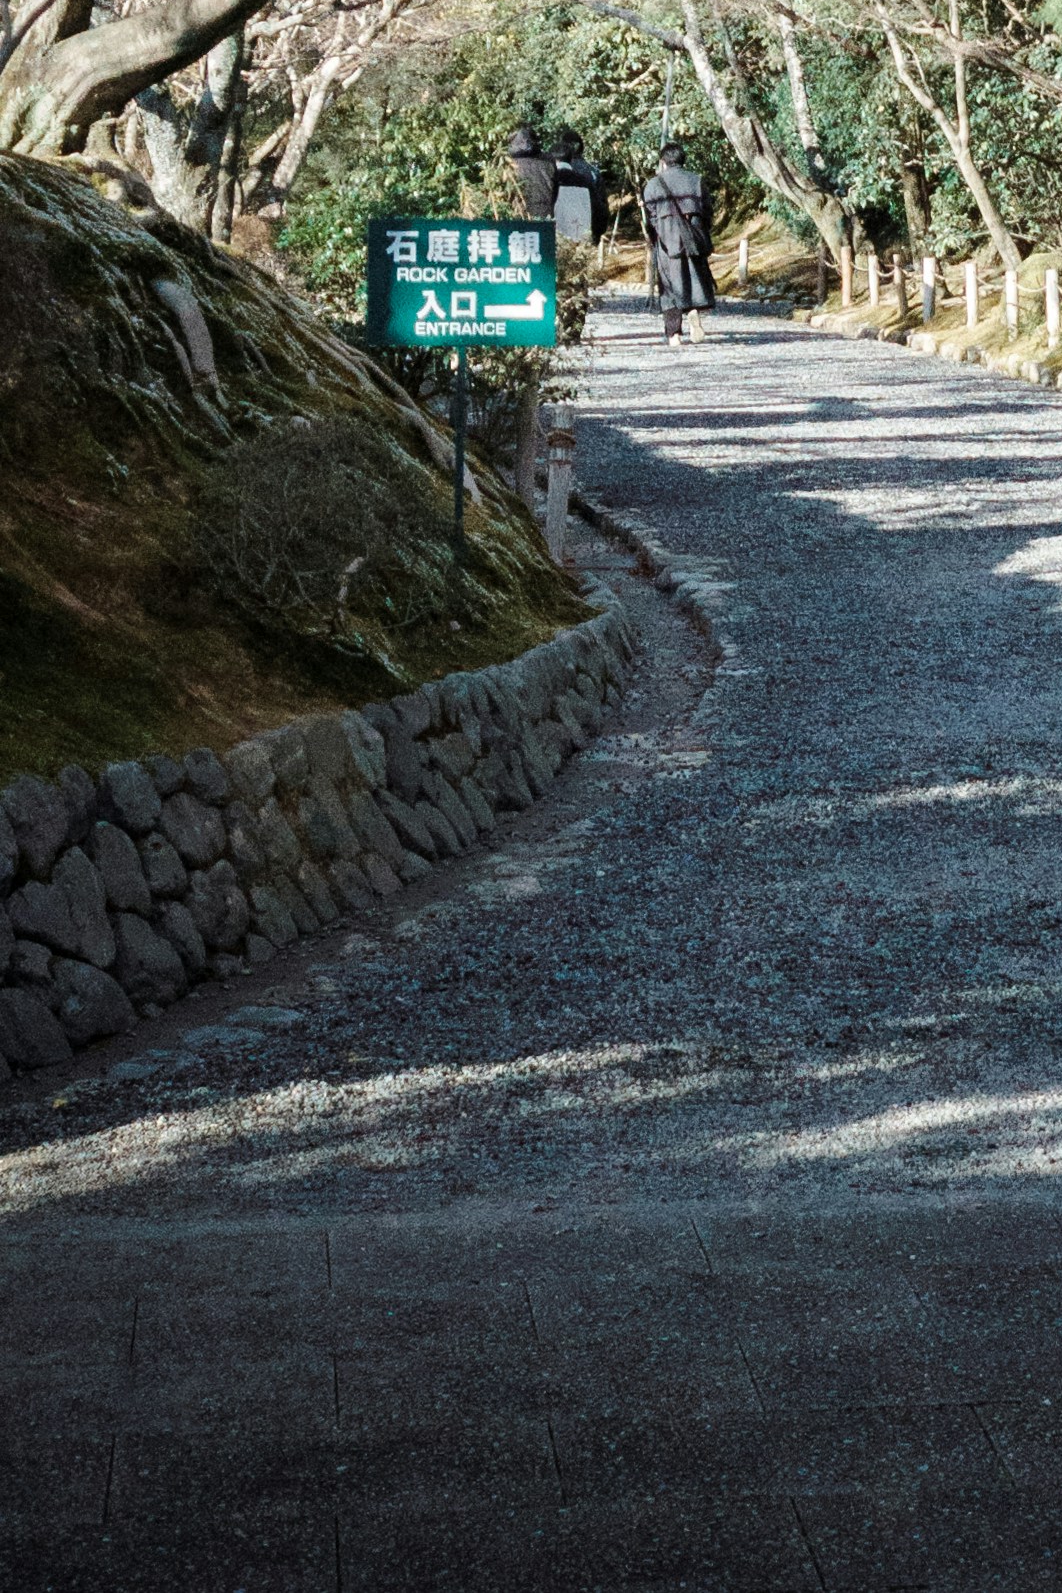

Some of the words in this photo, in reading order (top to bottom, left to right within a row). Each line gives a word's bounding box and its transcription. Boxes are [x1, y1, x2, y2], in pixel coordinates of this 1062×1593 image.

[386, 229, 542, 264] 石庭拝観
[396, 267, 449, 283] ROCK
[454, 267, 532, 283] GARDEN
[416, 289, 478, 320] 入口
[414, 322, 507, 337] ENTRANCE
